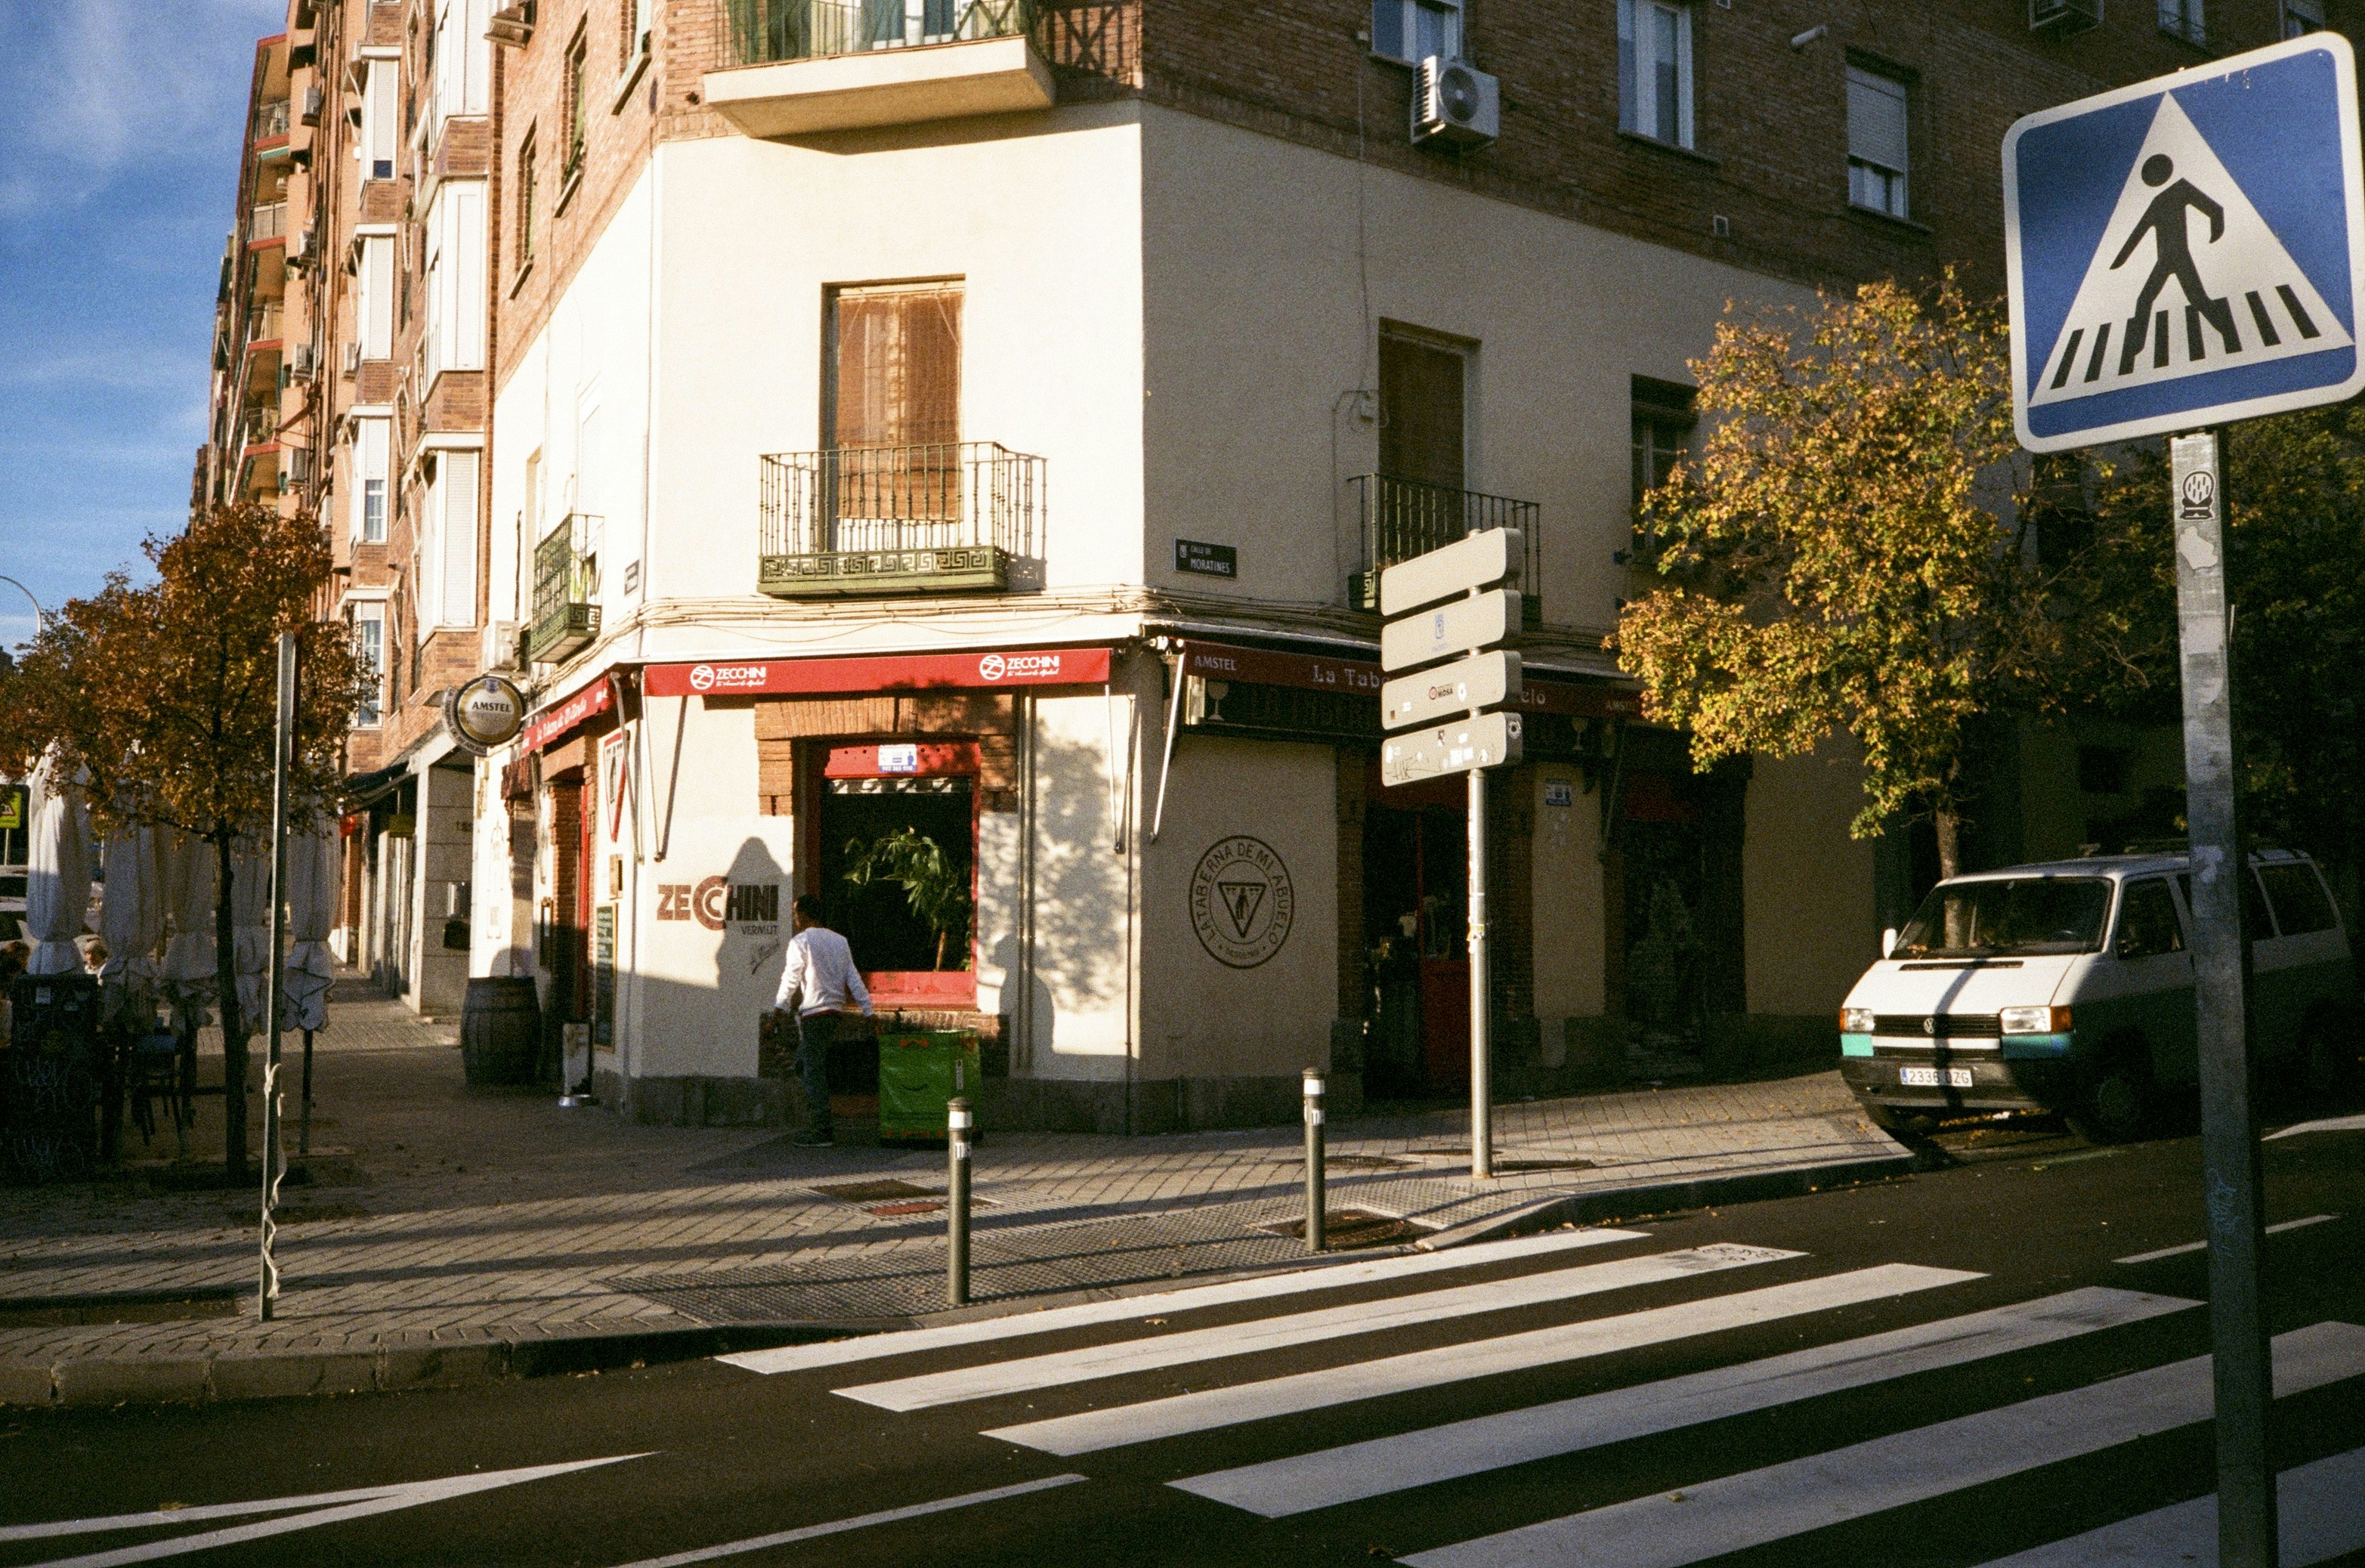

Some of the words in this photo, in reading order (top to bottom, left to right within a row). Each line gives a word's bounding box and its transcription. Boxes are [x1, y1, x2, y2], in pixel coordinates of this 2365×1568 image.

[1190, 558, 1230, 574] MORATINES
[1006, 655, 1060, 670] ZECCHINI
[1195, 655, 1237, 671] AMSTEL
[716, 666, 766, 680] ZECCHINI
[1312, 664, 1336, 684] La
[472, 701, 511, 713] AMSTEL
[1237, 843, 1254, 858] DE
[1255, 849, 1274, 871] MI
[1196, 845, 1234, 920] TABERNA
[657, 875, 779, 930] ZECCHINI
[1269, 874, 1288, 945] ABUELO
[740, 925, 779, 935] VERMUT
[1201, 920, 1216, 942] LA
